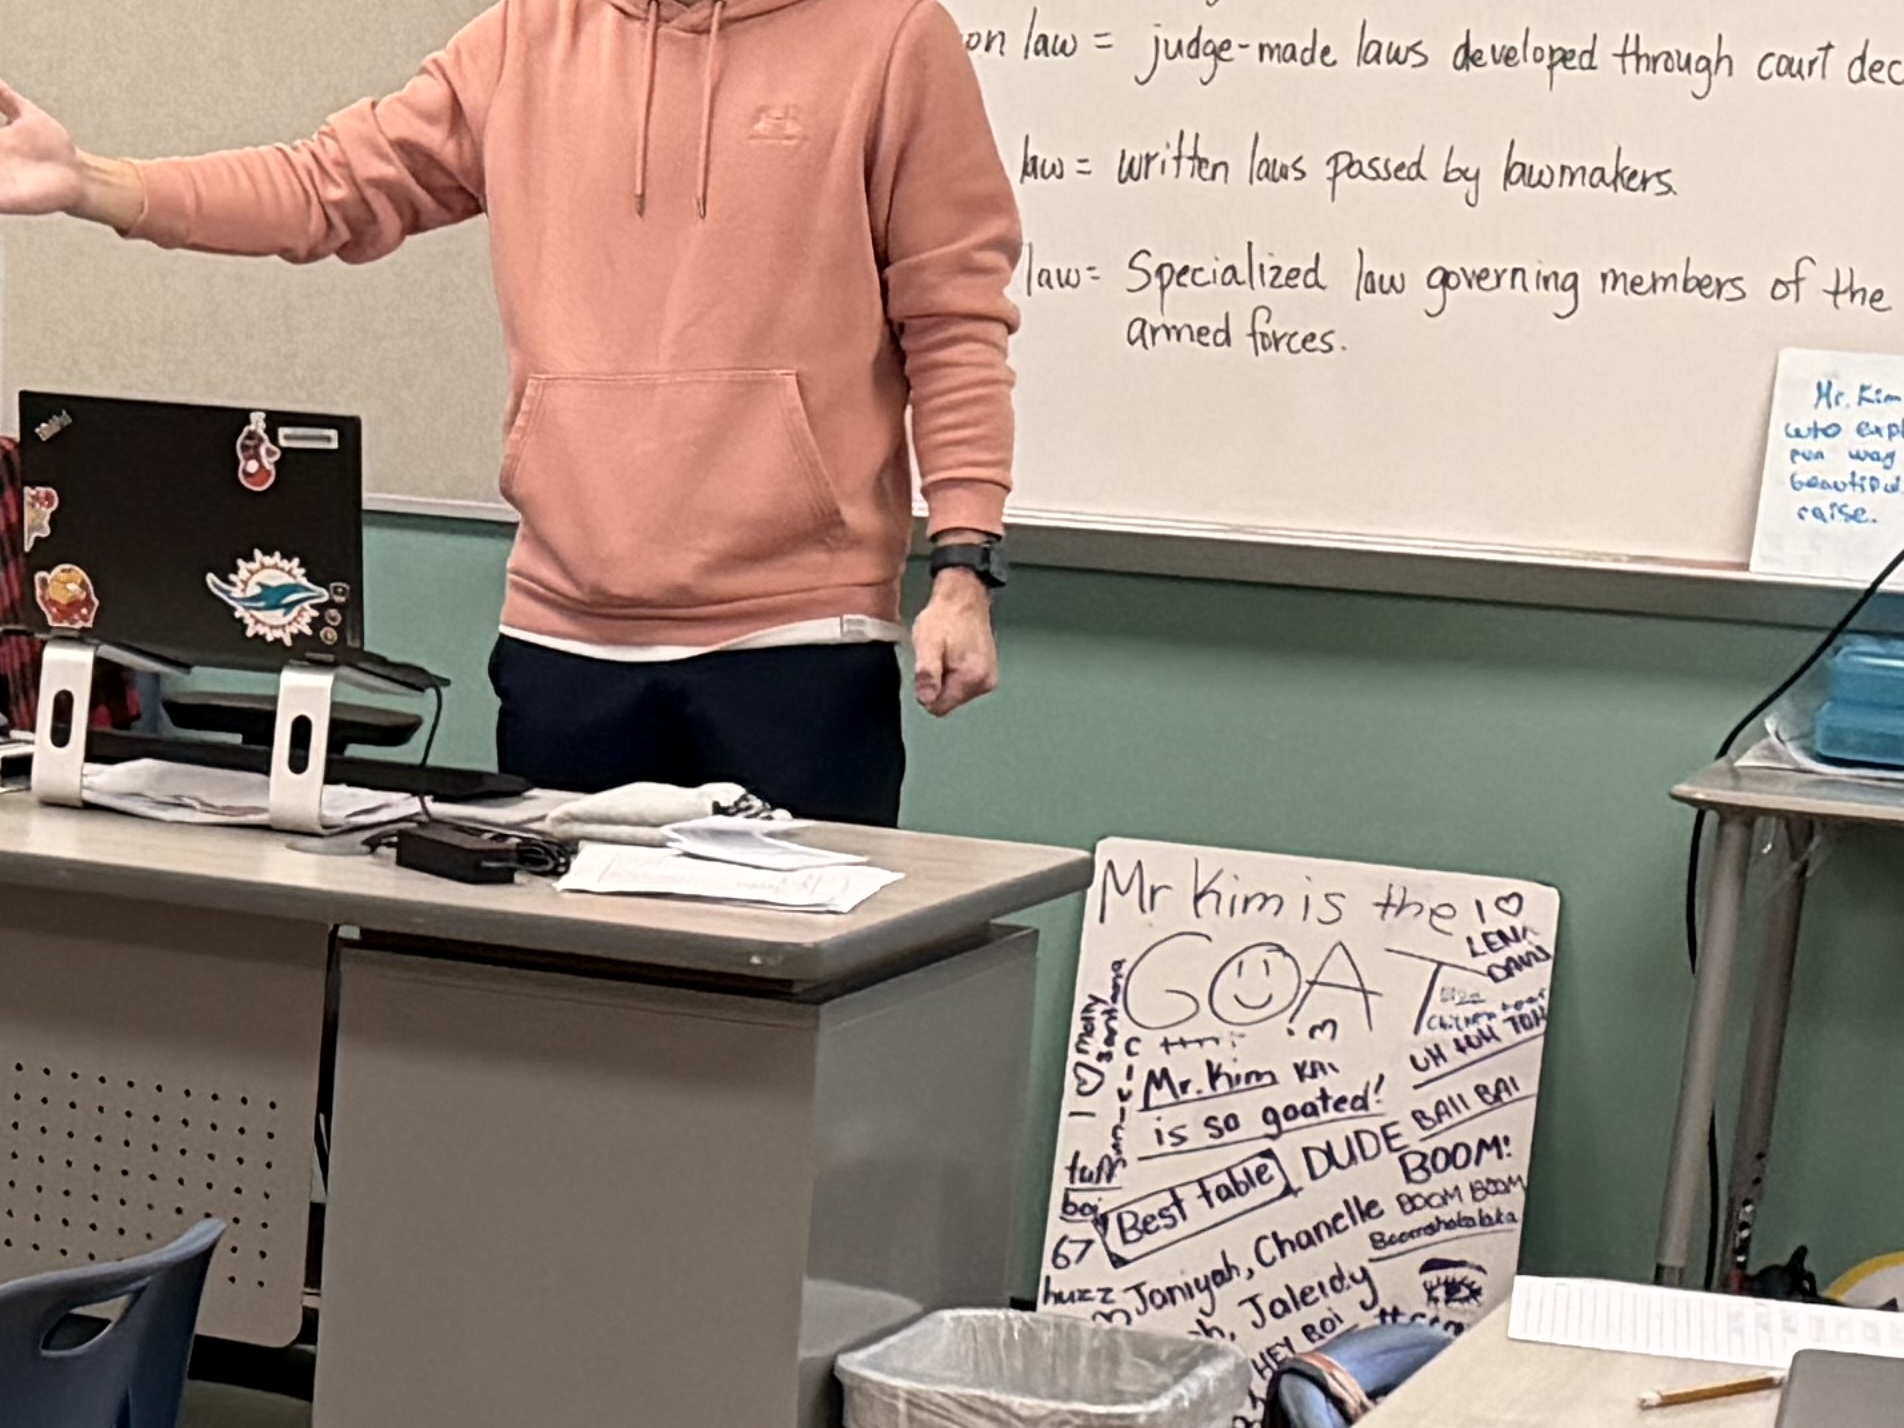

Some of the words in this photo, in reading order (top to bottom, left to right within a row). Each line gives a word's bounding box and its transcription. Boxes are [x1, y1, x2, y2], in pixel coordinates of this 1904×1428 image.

[1024, 6, 1078, 61] law
[1135, 23, 1338, 87] judge-made
[1356, 19, 1431, 68] laws
[1452, 27, 1599, 92] developed
[1613, 33, 1734, 100] through
[1019, 134, 1065, 185] law
[1117, 129, 1230, 185] written
[1248, 131, 1308, 187] laws
[1325, 144, 1427, 203] passed
[1443, 145, 1481, 208] by
[1125, 241, 1327, 317] Specialized
[1356, 248, 1406, 303] law
[1426, 260, 1581, 320] governing
[1600, 257, 1748, 303] members
[1770, 255, 1817, 304] of
[1822, 267, 1894, 314] the
[1125, 311, 1233, 349] armed
[1246, 304, 1348, 358] forces.
[1857, 383, 1903, 407] Kim
[1099, 859, 1174, 924] Mr
[1193, 857, 1285, 919] Kim
[1302, 875, 1346, 925] is
[1372, 883, 1457, 936] the
[1205, 1058, 1278, 1093] Kim
[1154, 1116, 1188, 1147] is
[1204, 1112, 1240, 1139] so
[1301, 1120, 1411, 1181] DUDE
[1116, 1187, 1188, 1246] Best
[1195, 1162, 1275, 1210] table
[1253, 1194, 1385, 1268] Chanelle
[1051, 1234, 1096, 1270] 67
